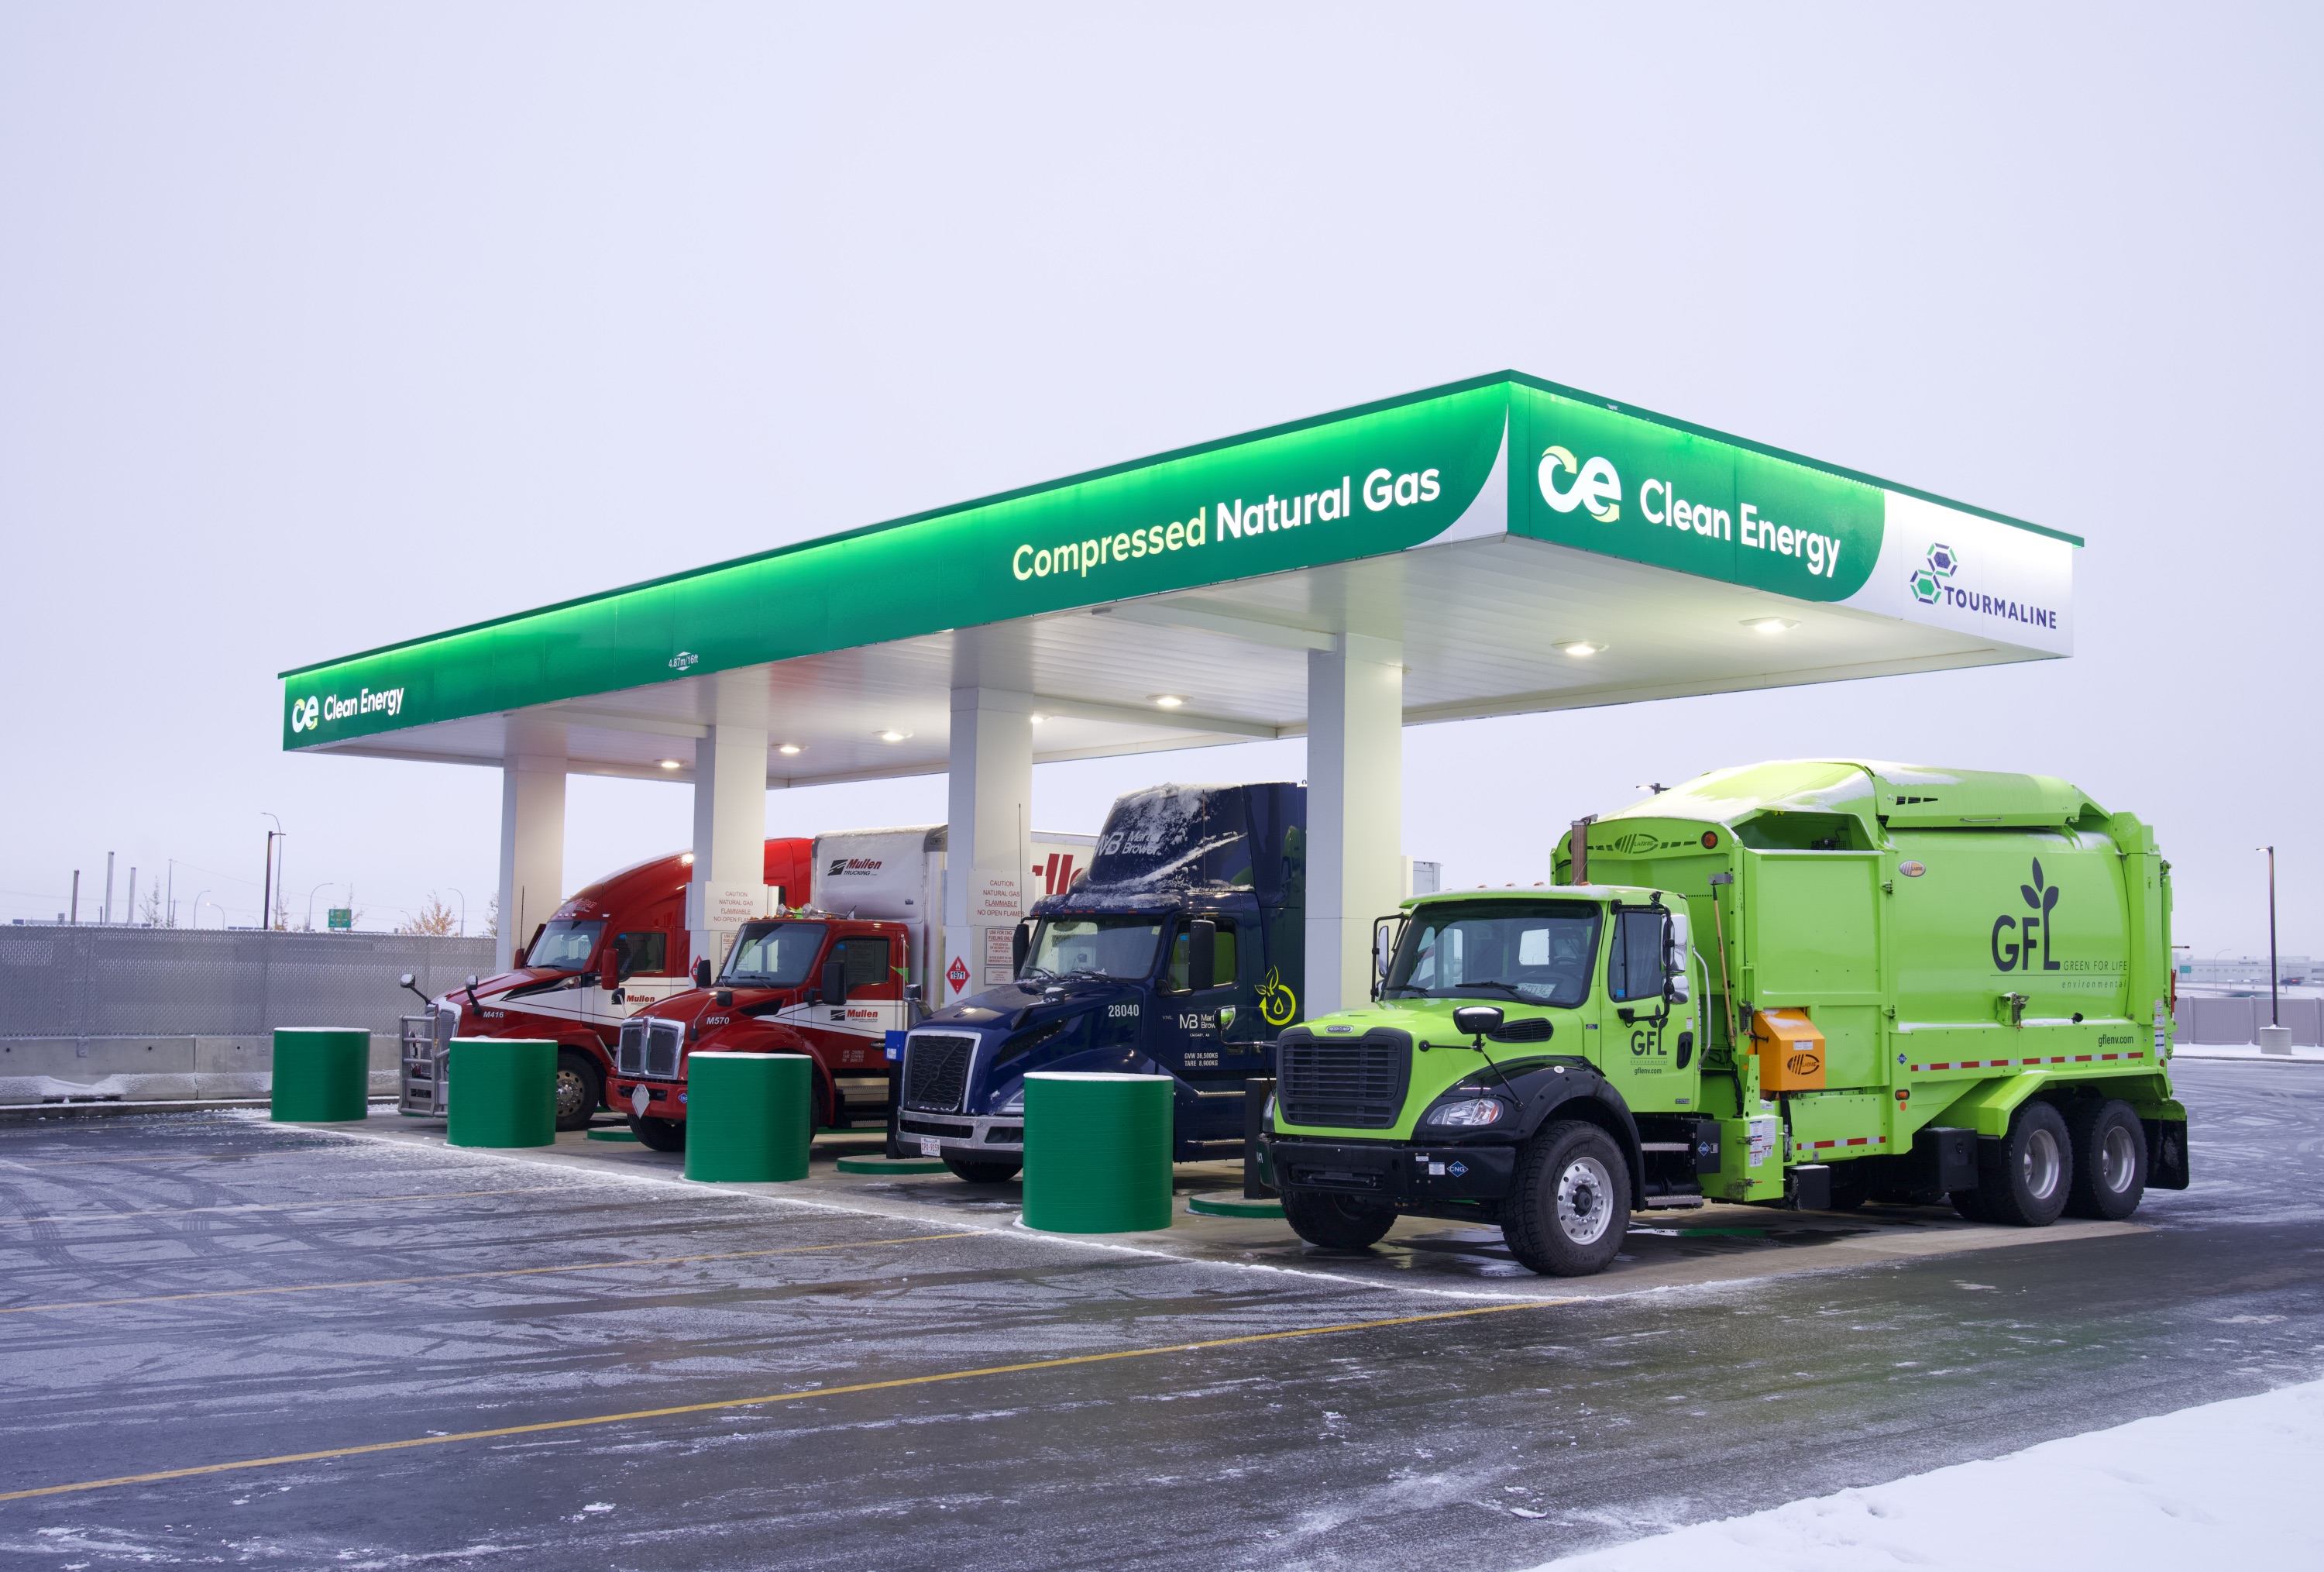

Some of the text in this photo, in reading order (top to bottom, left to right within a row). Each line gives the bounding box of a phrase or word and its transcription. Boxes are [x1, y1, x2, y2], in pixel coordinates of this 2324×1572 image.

[1012, 468, 1441, 580] Compressed Natural Gas
[1640, 479, 1731, 541] Clean
[1741, 502, 1841, 578] Energy
[1944, 586, 2057, 630] TOURMALINE
[324, 694, 358, 721] Clean
[360, 687, 404, 716] Energy
[846, 858, 882, 870] Mullen
[1992, 905, 2061, 972] GFL
[2064, 961, 2127, 971] GREEN FOR LIFE
[2061, 979, 2127, 989] environmental
[1108, 1004, 1140, 1017] 28040
[1631, 1027, 1668, 1056] GFL
[2098, 1034, 2134, 1047] gflenv.com
[1634, 1067, 1662, 1075] gflenv.com
